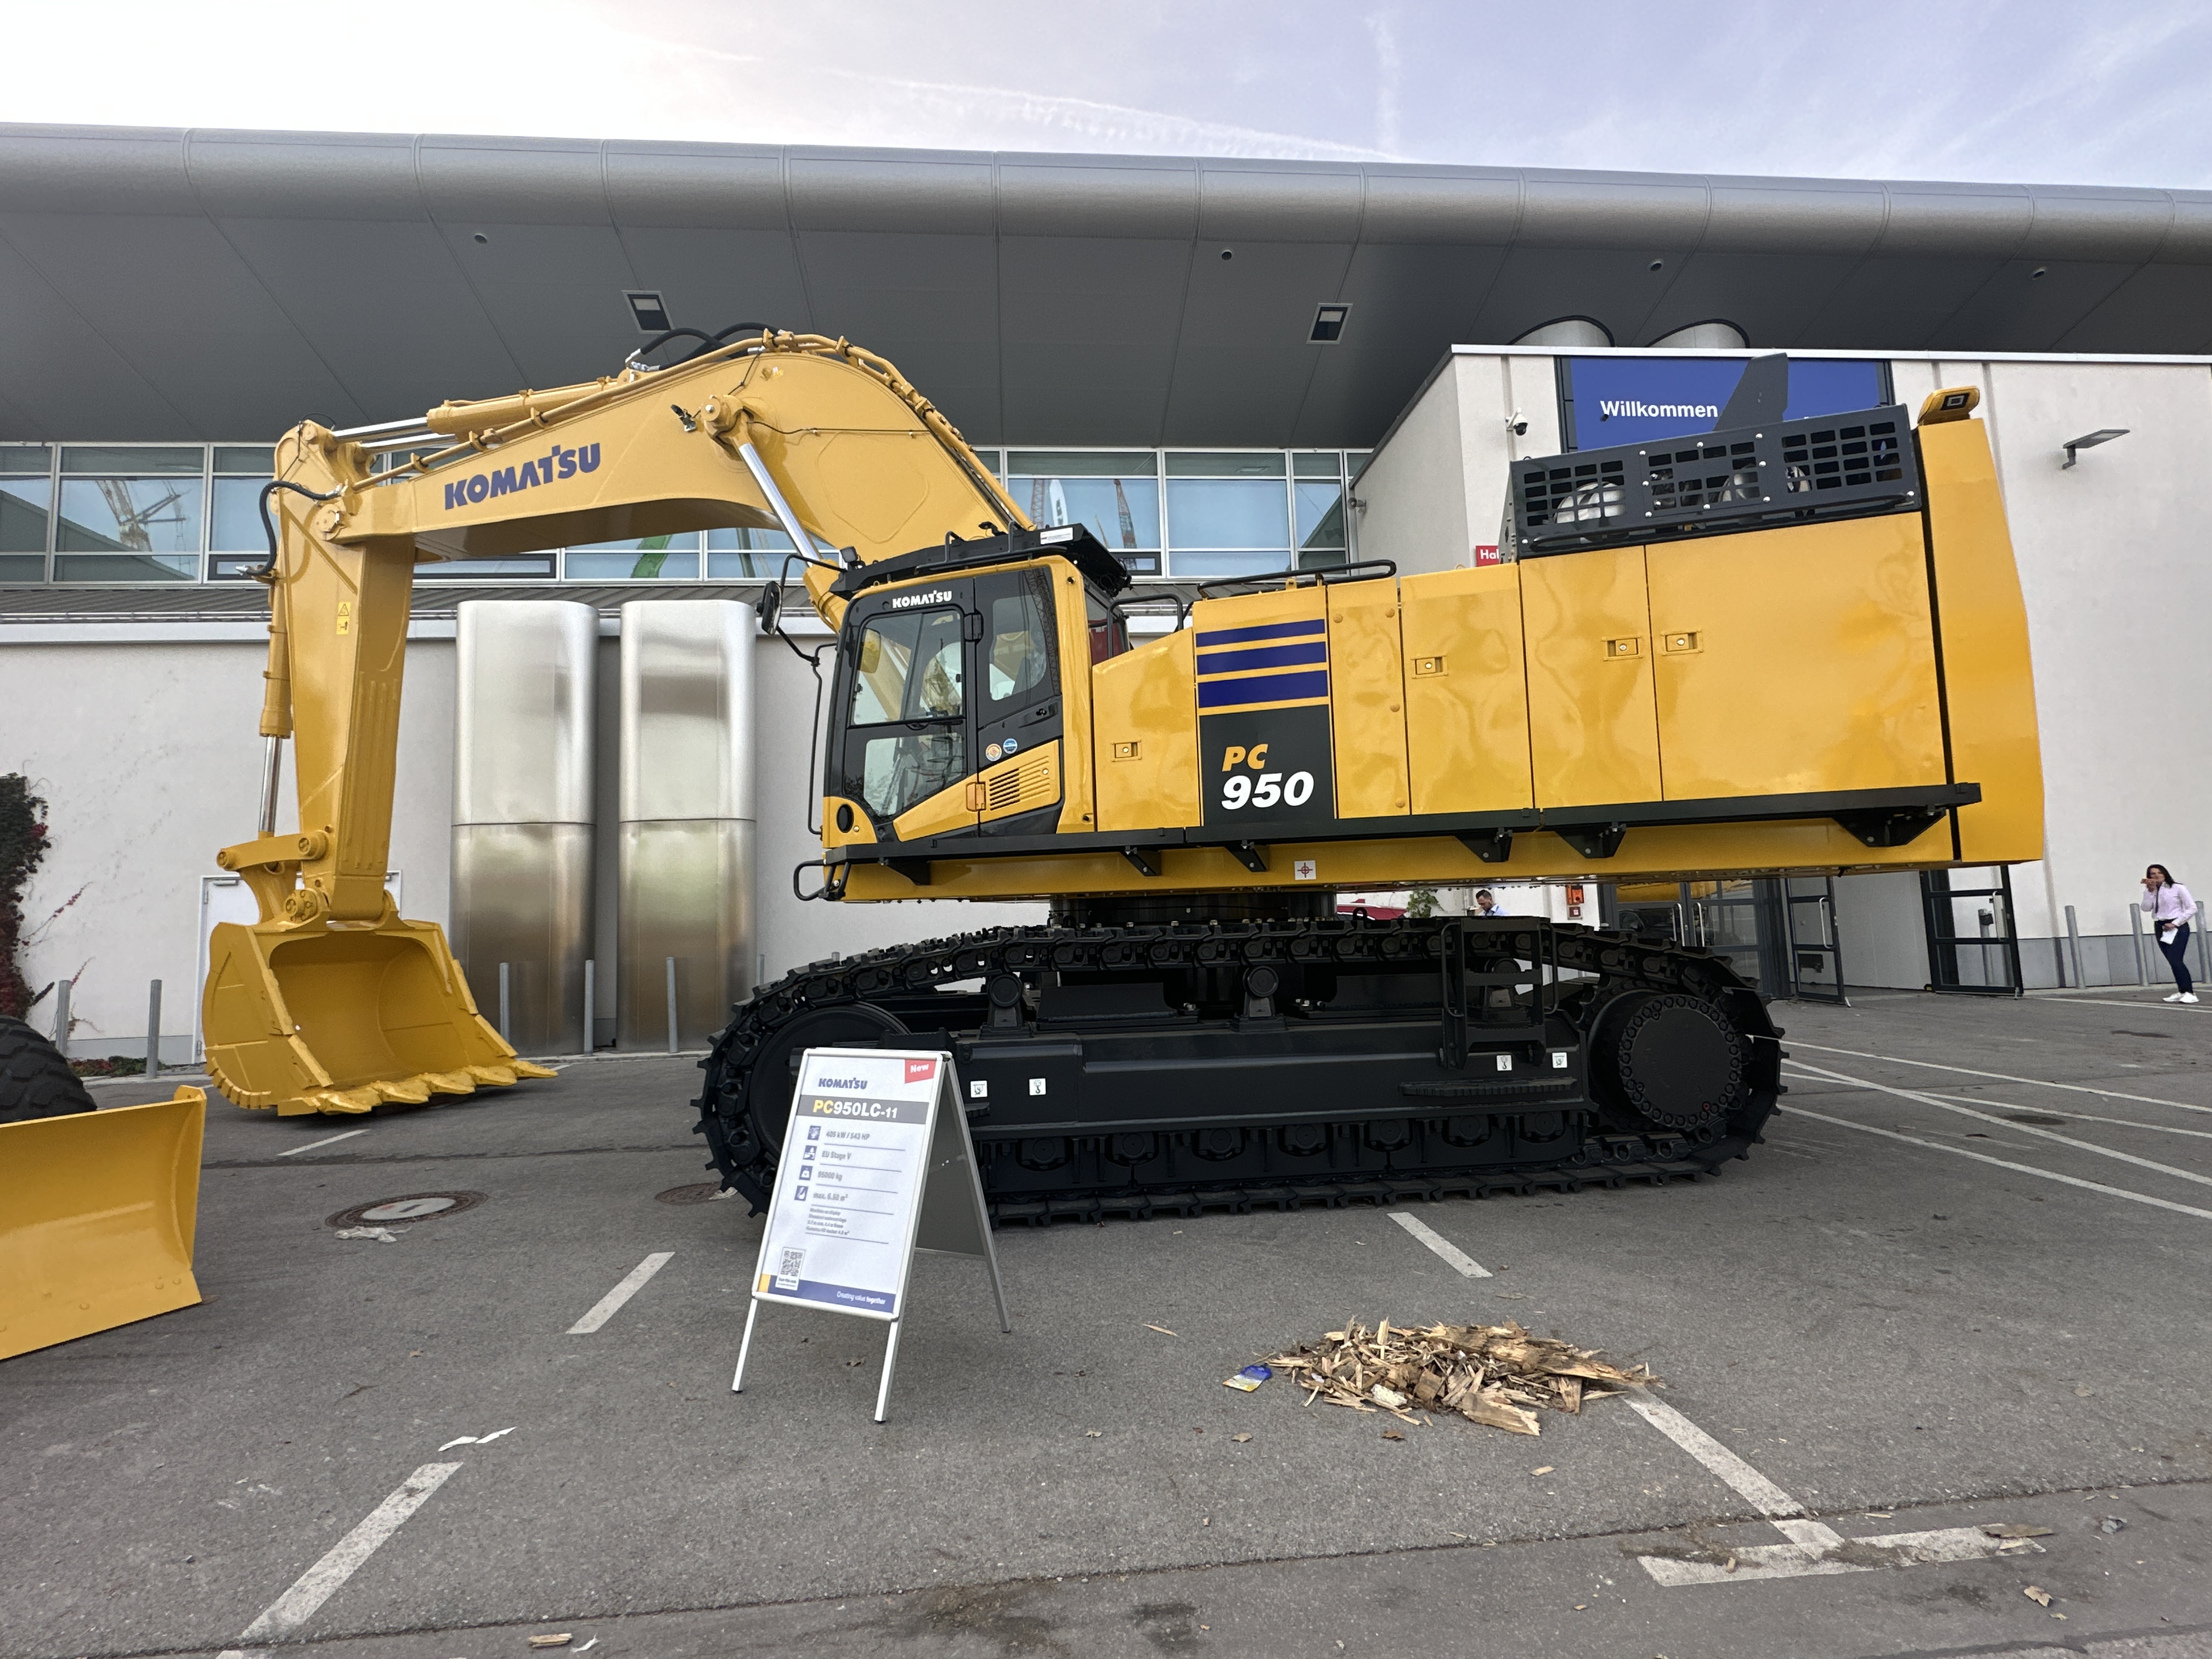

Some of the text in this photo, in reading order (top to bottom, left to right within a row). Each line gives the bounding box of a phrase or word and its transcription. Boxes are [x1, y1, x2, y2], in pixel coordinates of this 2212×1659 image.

[1600, 400, 1718, 417] Willkommen
[444, 443, 601, 511] KOMATSU
[892, 590, 952, 608] KOMATSU
[1222, 744, 1268, 772] PC
[1221, 771, 1314, 810] 950
[910, 1064, 929, 1073] New
[818, 1077, 868, 1090] KOMATSU
[812, 1099, 898, 1119] PC950LC-11
